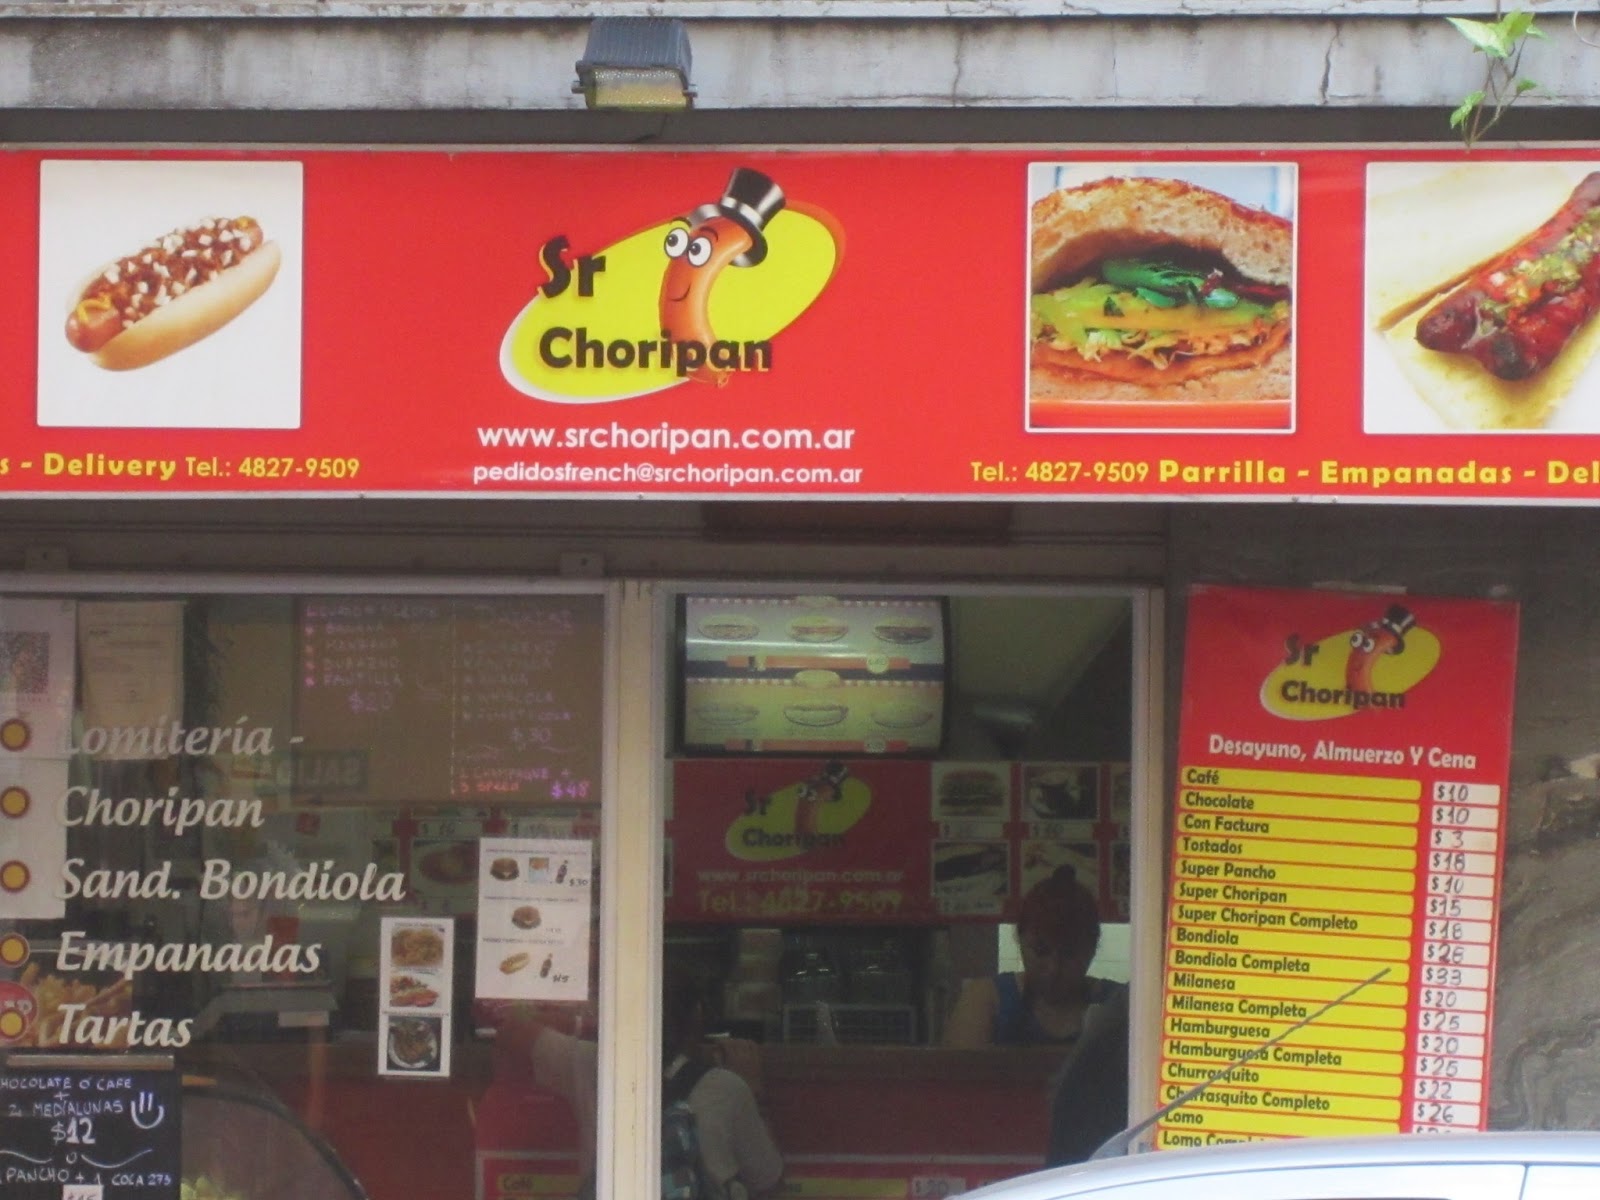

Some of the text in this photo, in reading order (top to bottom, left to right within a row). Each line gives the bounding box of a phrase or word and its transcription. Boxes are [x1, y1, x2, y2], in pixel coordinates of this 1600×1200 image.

[539, 235, 606, 298] Sr
[539, 326, 772, 377] Choripan
[478, 421, 855, 454] www.srchoripan.com.ar
[44, 453, 176, 480] Delivery
[186, 456, 231, 477] Tel.:
[238, 457, 359, 478] 4827-9509
[473, 462, 862, 487] pedidosfrench@srchoripan.com.ar
[971, 461, 1017, 482] Tel.:
[1025, 461, 1149, 482] 4827-9509
[1159, 459, 1285, 483] Parrilla
[1321, 460, 1512, 488] Empanadas
[1284, 633, 1320, 667] Sr
[1281, 681, 1406, 709] Choripan
[1209, 735, 1477, 769] Desayuno, Almuerzo Y Cena
[1187, 768, 1220, 785] Café
[60, 786, 264, 836] Choripan
[1185, 792, 1254, 811] Chocolate
[1184, 814, 1270, 834] Con Factura
[1182, 837, 1243, 856] Tostados
[60, 858, 407, 901] Sand. Bondiola
[1181, 860, 1276, 879] Super Pancho
[1179, 882, 1288, 904] Super Choripan
[1178, 905, 1358, 931] Super Choripan Completo
[1176, 927, 1239, 945] Bondiola
[56, 931, 322, 979] Empanadas
[1175, 950, 1310, 973] Bondiola Completa
[1173, 972, 1235, 990] Milanesa
[1172, 995, 1307, 1018] Milanesa Completa
[57, 1003, 194, 1047] Tartas
[1170, 1018, 1270, 1038] Hamburguesa
[1273, 1047, 1342, 1067] Completa
[1166, 1084, 1330, 1111] Chrasquito Completo
[1164, 1110, 1203, 1125] Lomo
[51, 1117, 96, 1145] $12
[1163, 1130, 1202, 1147] Lomo
[6, 1167, 70, 1183] PANCHO
